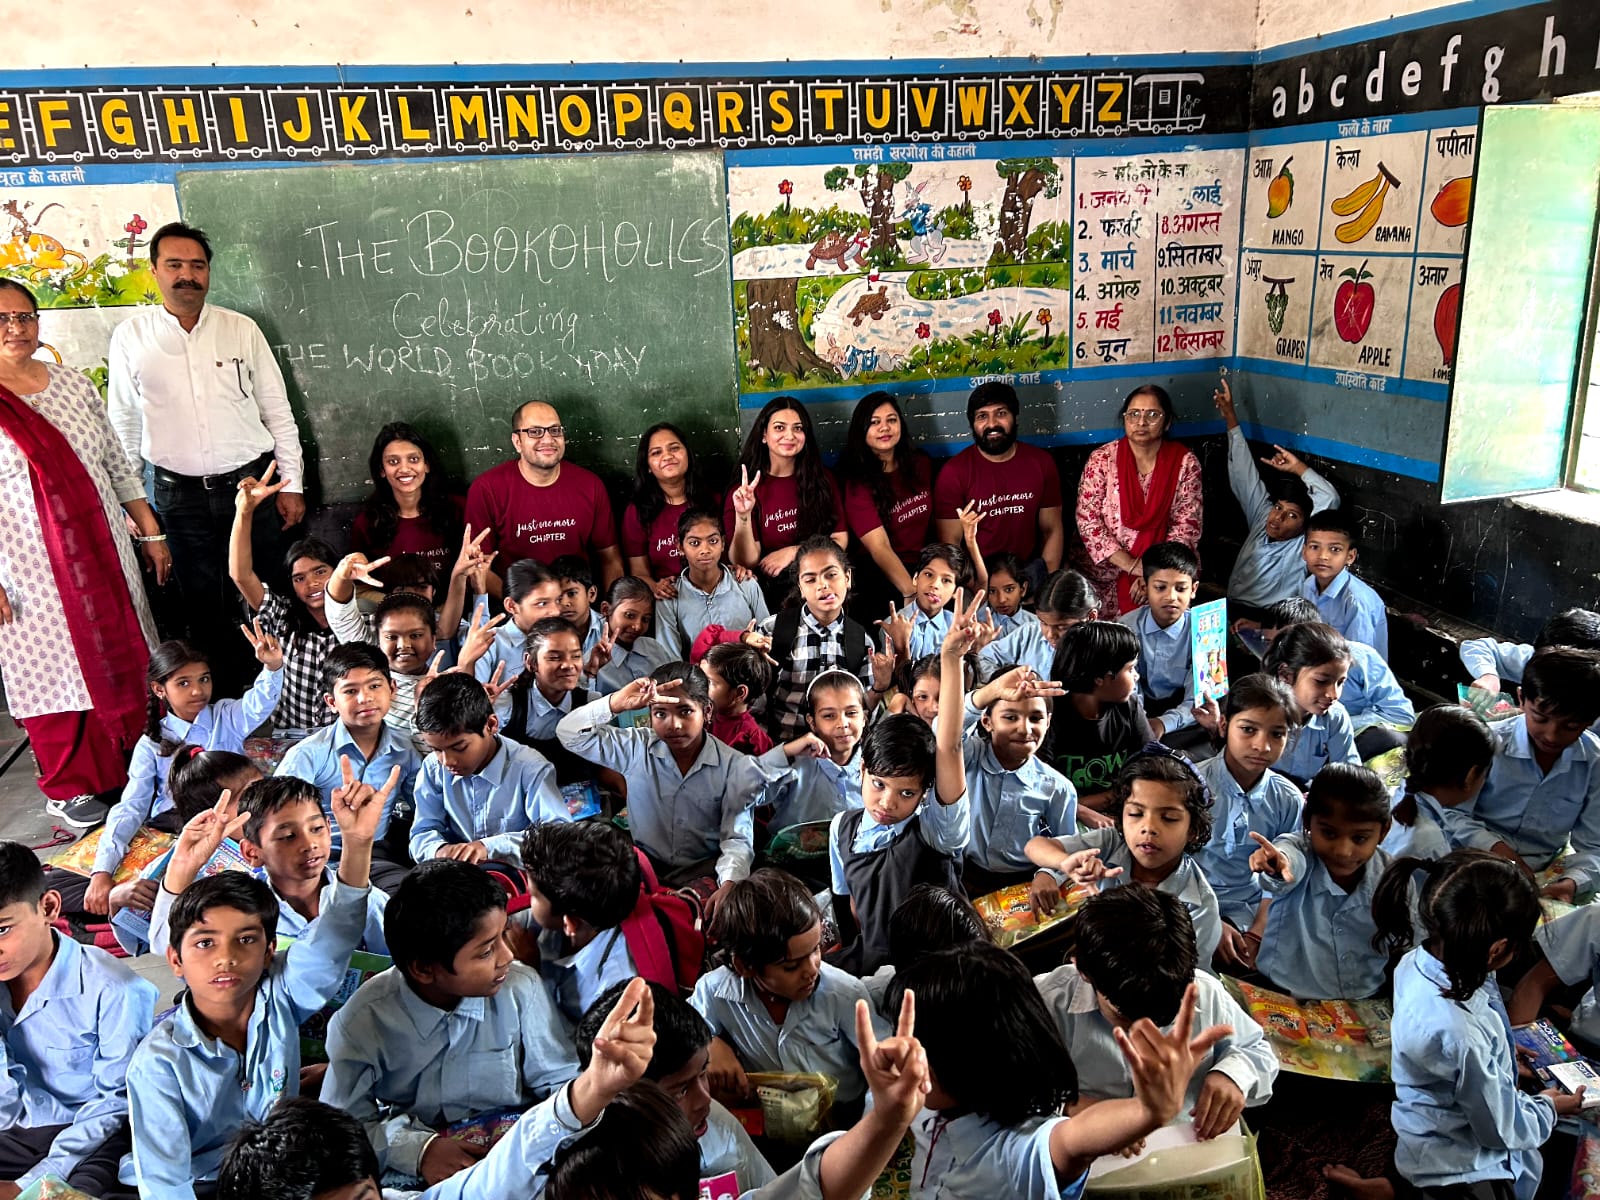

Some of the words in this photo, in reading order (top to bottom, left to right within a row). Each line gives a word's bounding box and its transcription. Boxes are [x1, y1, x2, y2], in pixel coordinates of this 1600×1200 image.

[1272, 86, 1287, 118] a
[1298, 67, 1314, 115] b
[1330, 74, 1347, 107] c
[1366, 50, 1386, 102] d
[1401, 60, 1422, 96] e
[1440, 34, 1462, 92] f
[1482, 45, 1504, 103] g
[1538, 15, 1566, 78] h
[39, 101, 72, 147] F
[101, 99, 136, 146] G
[163, 98, 200, 145] H
[230, 97, 249, 142] I
[283, 97, 312, 142] J
[339, 95, 371, 142] K
[398, 96, 431, 140] L
[450, 95, 488, 140] M
[505, 95, 538, 138] N
[559, 95, 592, 137] O
[613, 92, 643, 136] P
[663, 91, 695, 132] Q
[717, 91, 745, 134] R
[769, 89, 794, 133] S
[815, 89, 844, 130] T
[865, 88, 892, 129] U
[911, 87, 939, 128] V
[958, 86, 988, 126] W
[1005, 85, 1034, 125] X
[1053, 84, 1081, 124] Y
[1097, 82, 1124, 122] Z
[931, 143, 945, 159] की
[947, 143, 977, 158] कहानी
[1436, 129, 1475, 159] पपीता
[1253, 158, 1274, 179] आम
[1336, 146, 1361, 170] केला
[28, 167, 44, 184] की
[46, 166, 87, 184] कहानी
[1179, 178, 1223, 210] ुलाई
[303, 220, 398, 280] THE
[407, 209, 726, 284] BOOKOHOLICS
[1272, 229, 1304, 246] MANGO
[1101, 241, 1137, 271] मार्च
[1417, 264, 1449, 287] अनार
[393, 292, 578, 351] Celebrating
[1095, 302, 1124, 331] मई
[343, 340, 452, 377] WORLD
[1094, 338, 1132, 362] जून
[1276, 337, 1306, 360] GRAPES
[1358, 345, 1392, 367] APPLE
[898, 504, 928, 523] CHAPTER
[977, 493, 998, 513] just
[1011, 492, 1034, 502] more
[516, 518, 539, 538] just
[553, 518, 577, 528] more
[764, 509, 785, 528] just
[529, 532, 566, 543] CHAPTER
[656, 533, 676, 552] just
